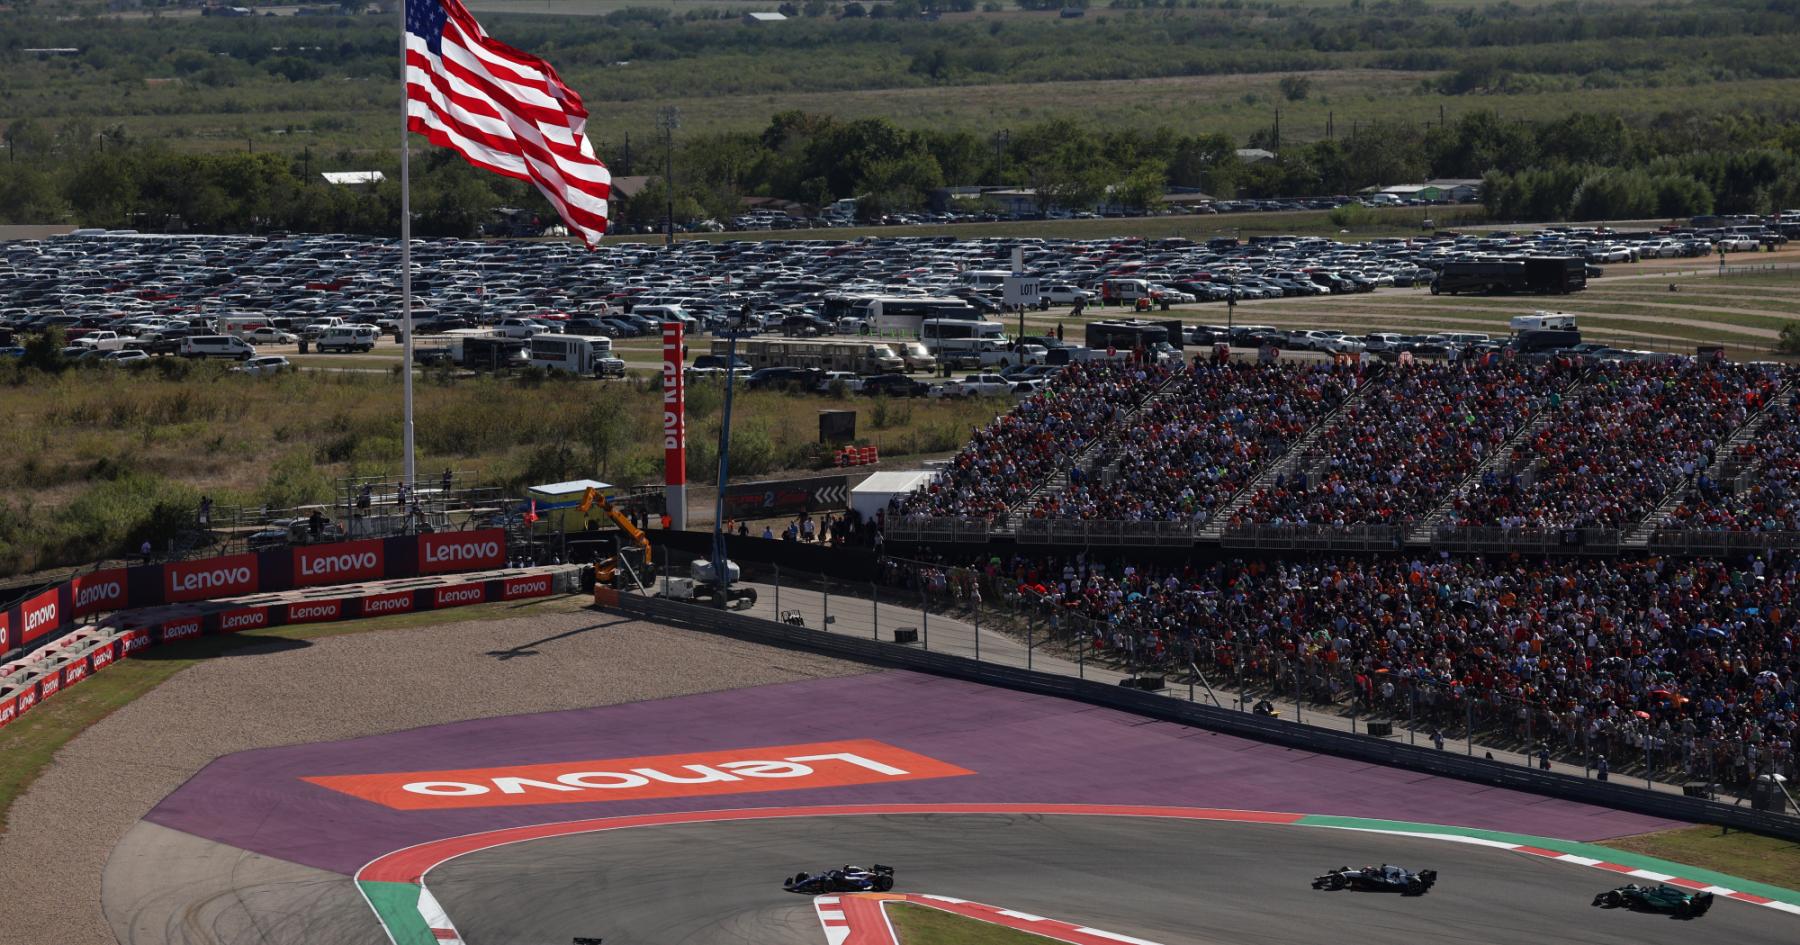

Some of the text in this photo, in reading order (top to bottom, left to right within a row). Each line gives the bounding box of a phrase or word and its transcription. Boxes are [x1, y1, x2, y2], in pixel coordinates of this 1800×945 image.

[1020, 284, 1033, 296] LOT
[426, 542, 498, 562] Lenovo
[301, 552, 376, 575] Lenovo
[172, 567, 250, 592] Lenovo
[76, 581, 120, 608] Lenovo
[438, 588, 480, 603] Lenovo
[506, 581, 546, 595] Lenovo
[290, 605, 336, 618] Lenovo
[364, 597, 409, 611] Lenovo
[25, 603, 55, 632] Lenovo
[222, 612, 263, 628] Lenovo
[164, 623, 198, 638] Lenovo
[402, 752, 910, 796] Lenovo
